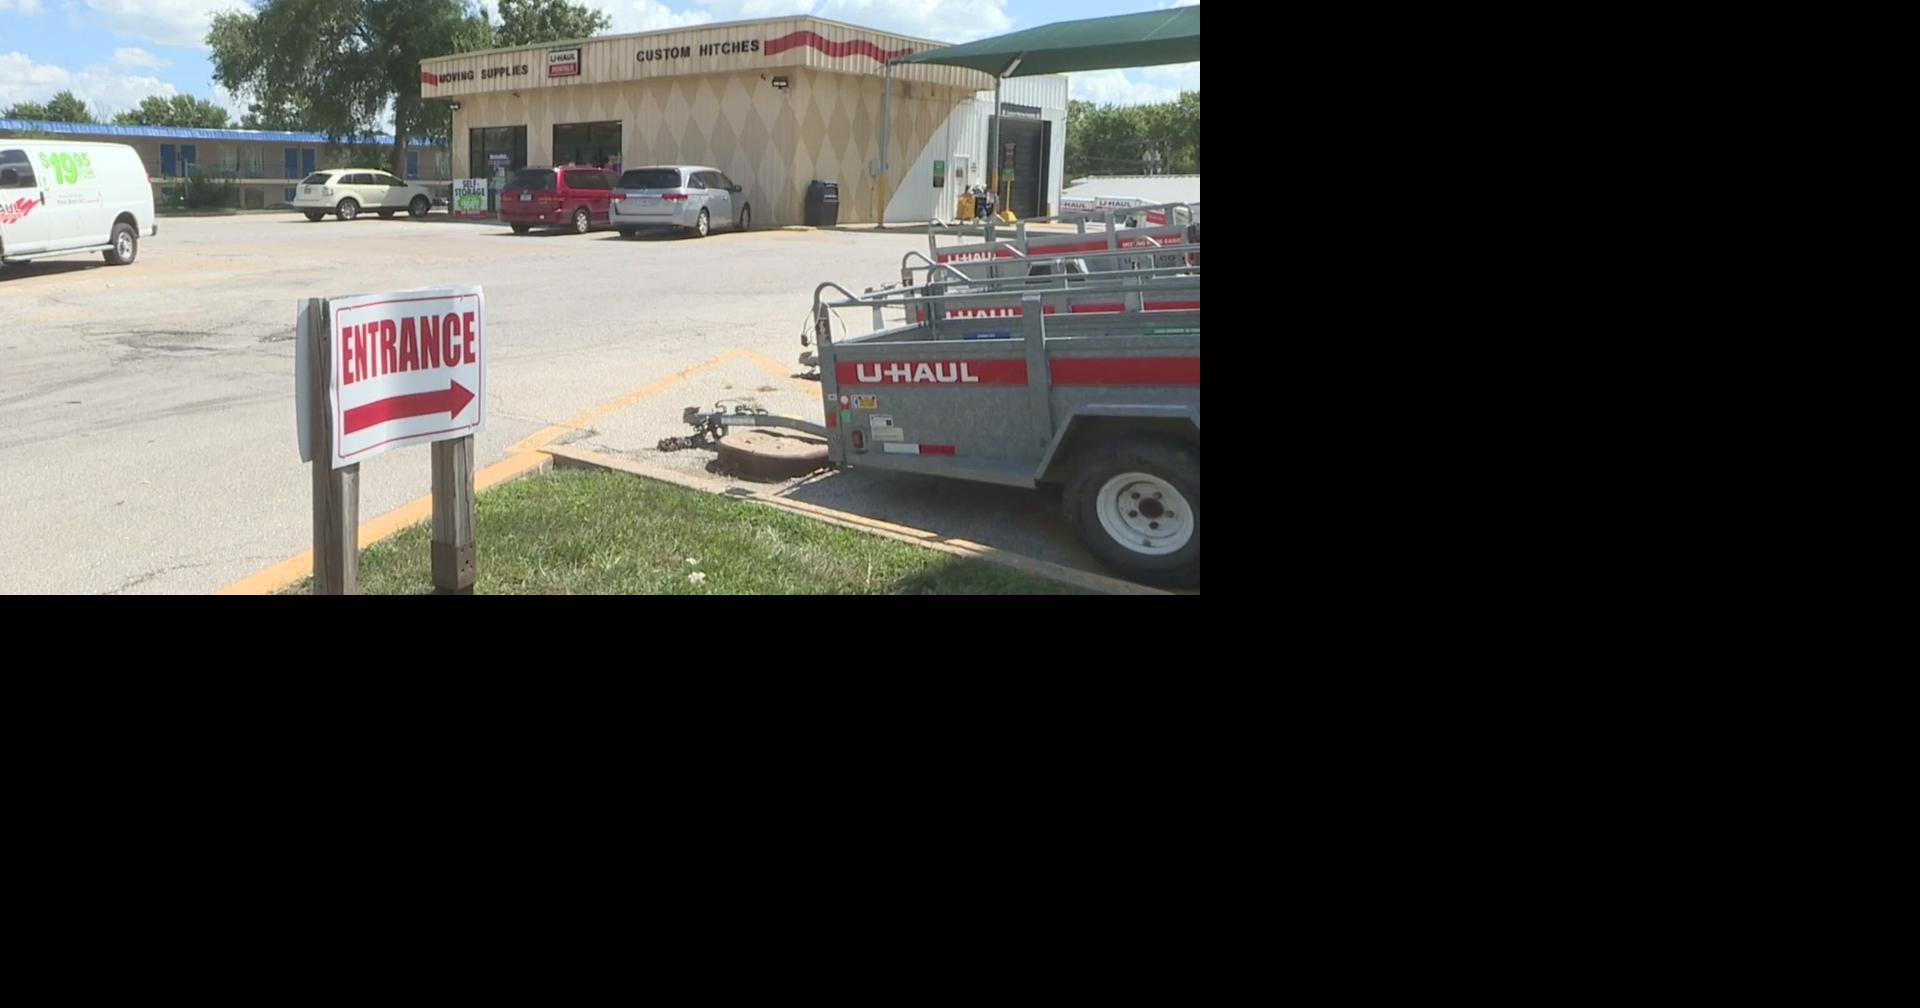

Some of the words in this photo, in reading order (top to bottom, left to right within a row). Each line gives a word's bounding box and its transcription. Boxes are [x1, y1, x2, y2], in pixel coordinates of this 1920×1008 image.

[550, 53, 576, 63] U-HAUL
[636, 46, 691, 62] CUSTOM
[699, 40, 760, 57] HITCHES
[439, 70, 474, 83] MOVING
[481, 64, 529, 80] SUPPLIES
[455, 188, 485, 197] STORAGE
[342, 312, 476, 385] ENTRANCE
[857, 362, 978, 383] U-HAUL
